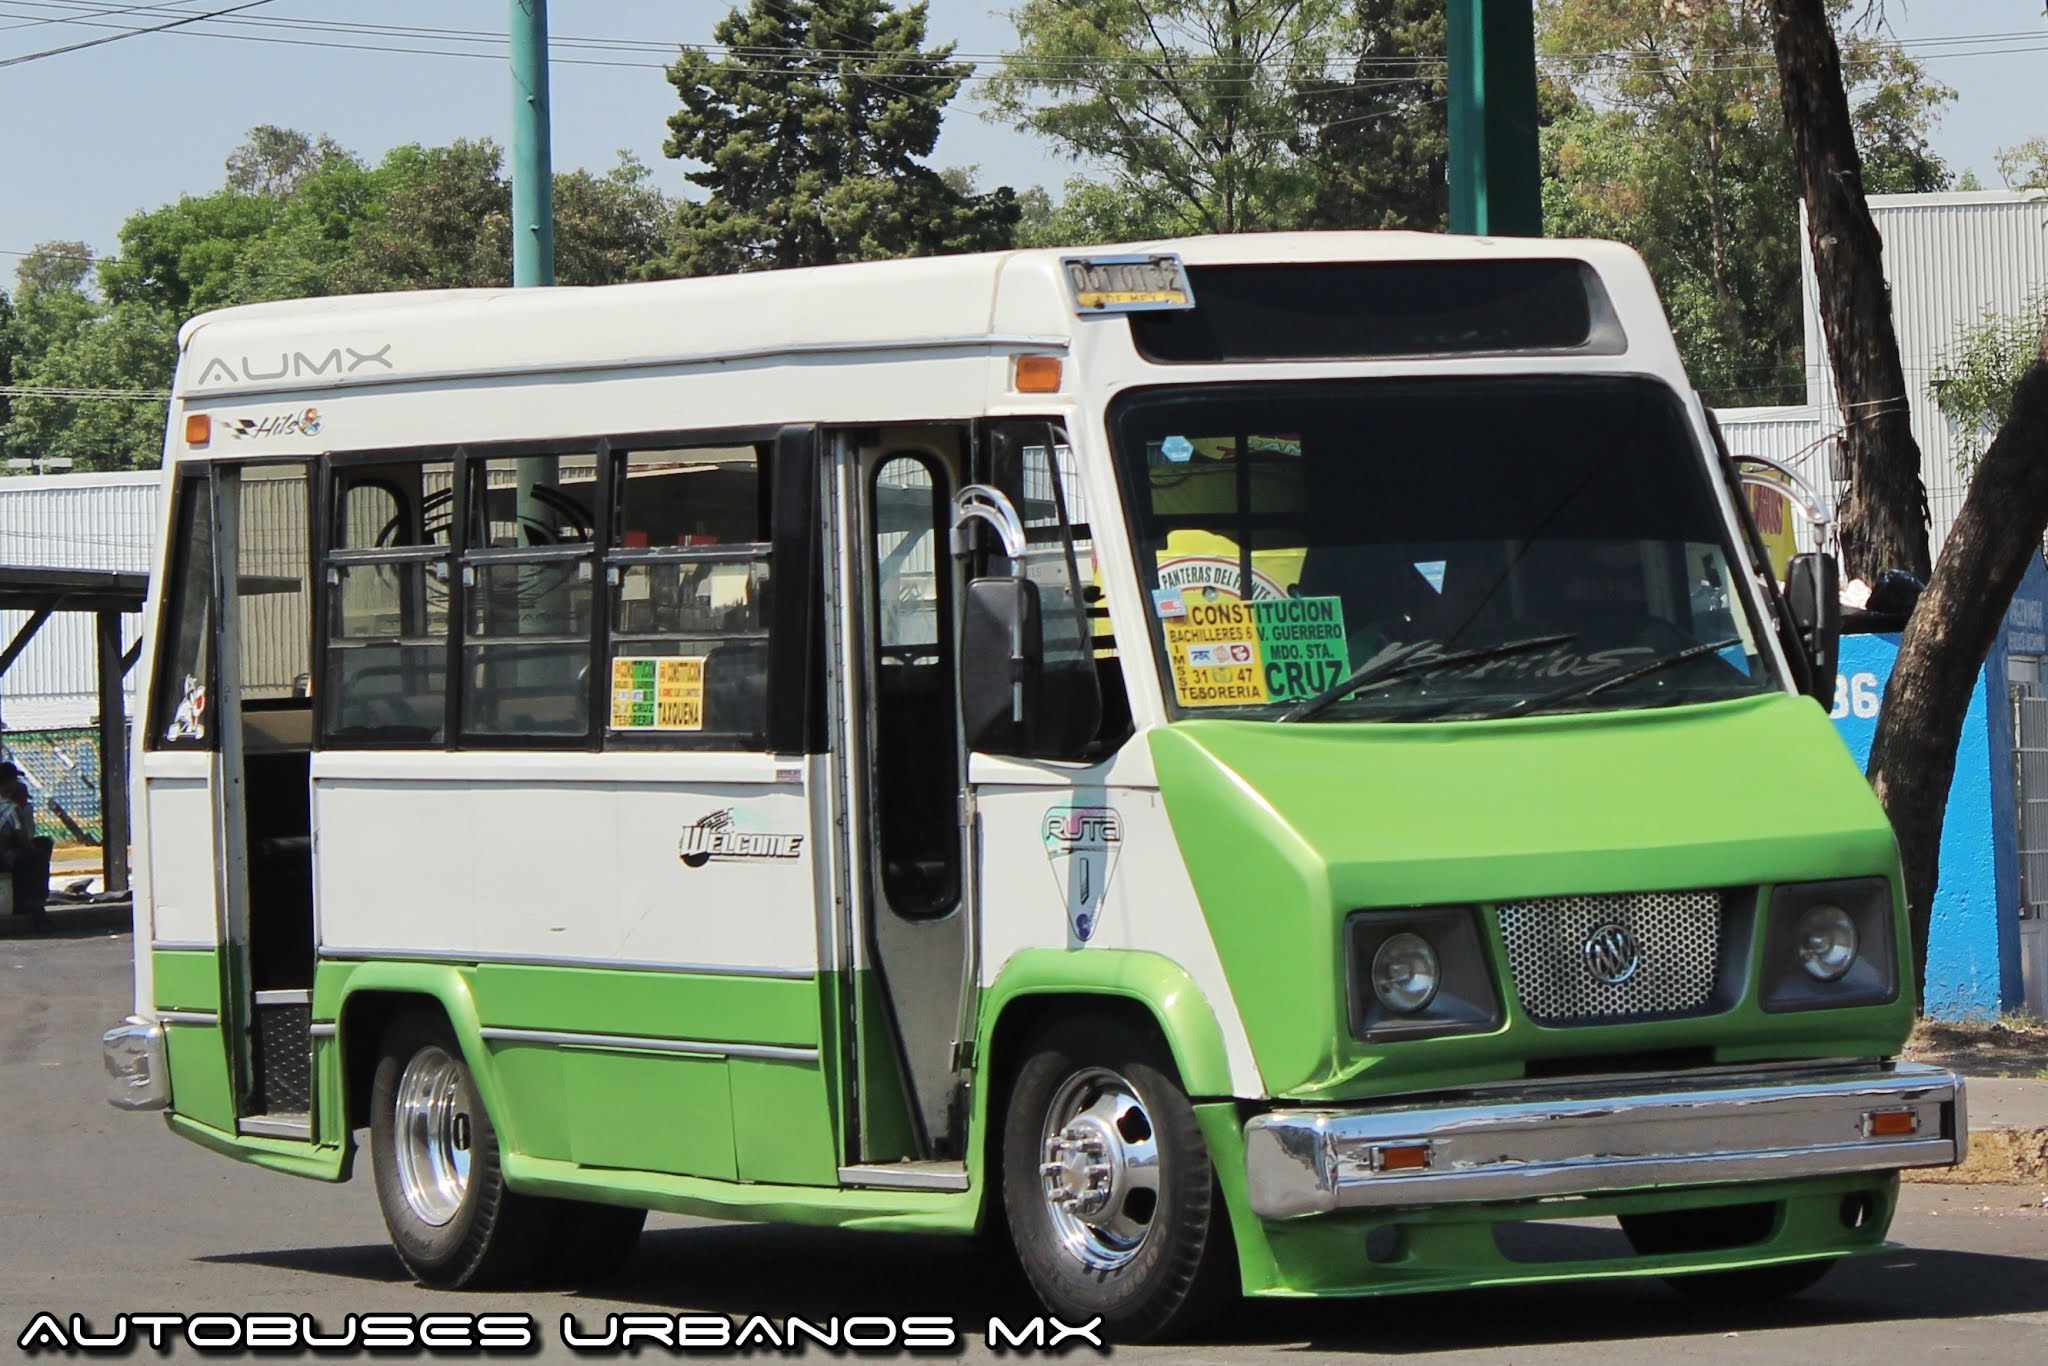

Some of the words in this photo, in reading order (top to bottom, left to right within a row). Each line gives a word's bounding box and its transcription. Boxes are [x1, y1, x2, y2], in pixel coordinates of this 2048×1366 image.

[1161, 566, 1212, 590] PANTERAS
[1214, 567, 1234, 588] DEL
[1191, 601, 1334, 626] CONSTITUCION
[1170, 626, 1243, 643] BACHILLERES
[1271, 623, 1343, 640] GUERRERO
[1270, 644, 1303, 660] MDO.
[1305, 643, 1335, 659] STA.
[1192, 668, 1209, 684] 31
[1237, 667, 1253, 683] 47
[1264, 660, 1343, 697] CRUZ
[1179, 684, 1261, 700] TESORERIA
[680, 825, 804, 858] WELCOME
